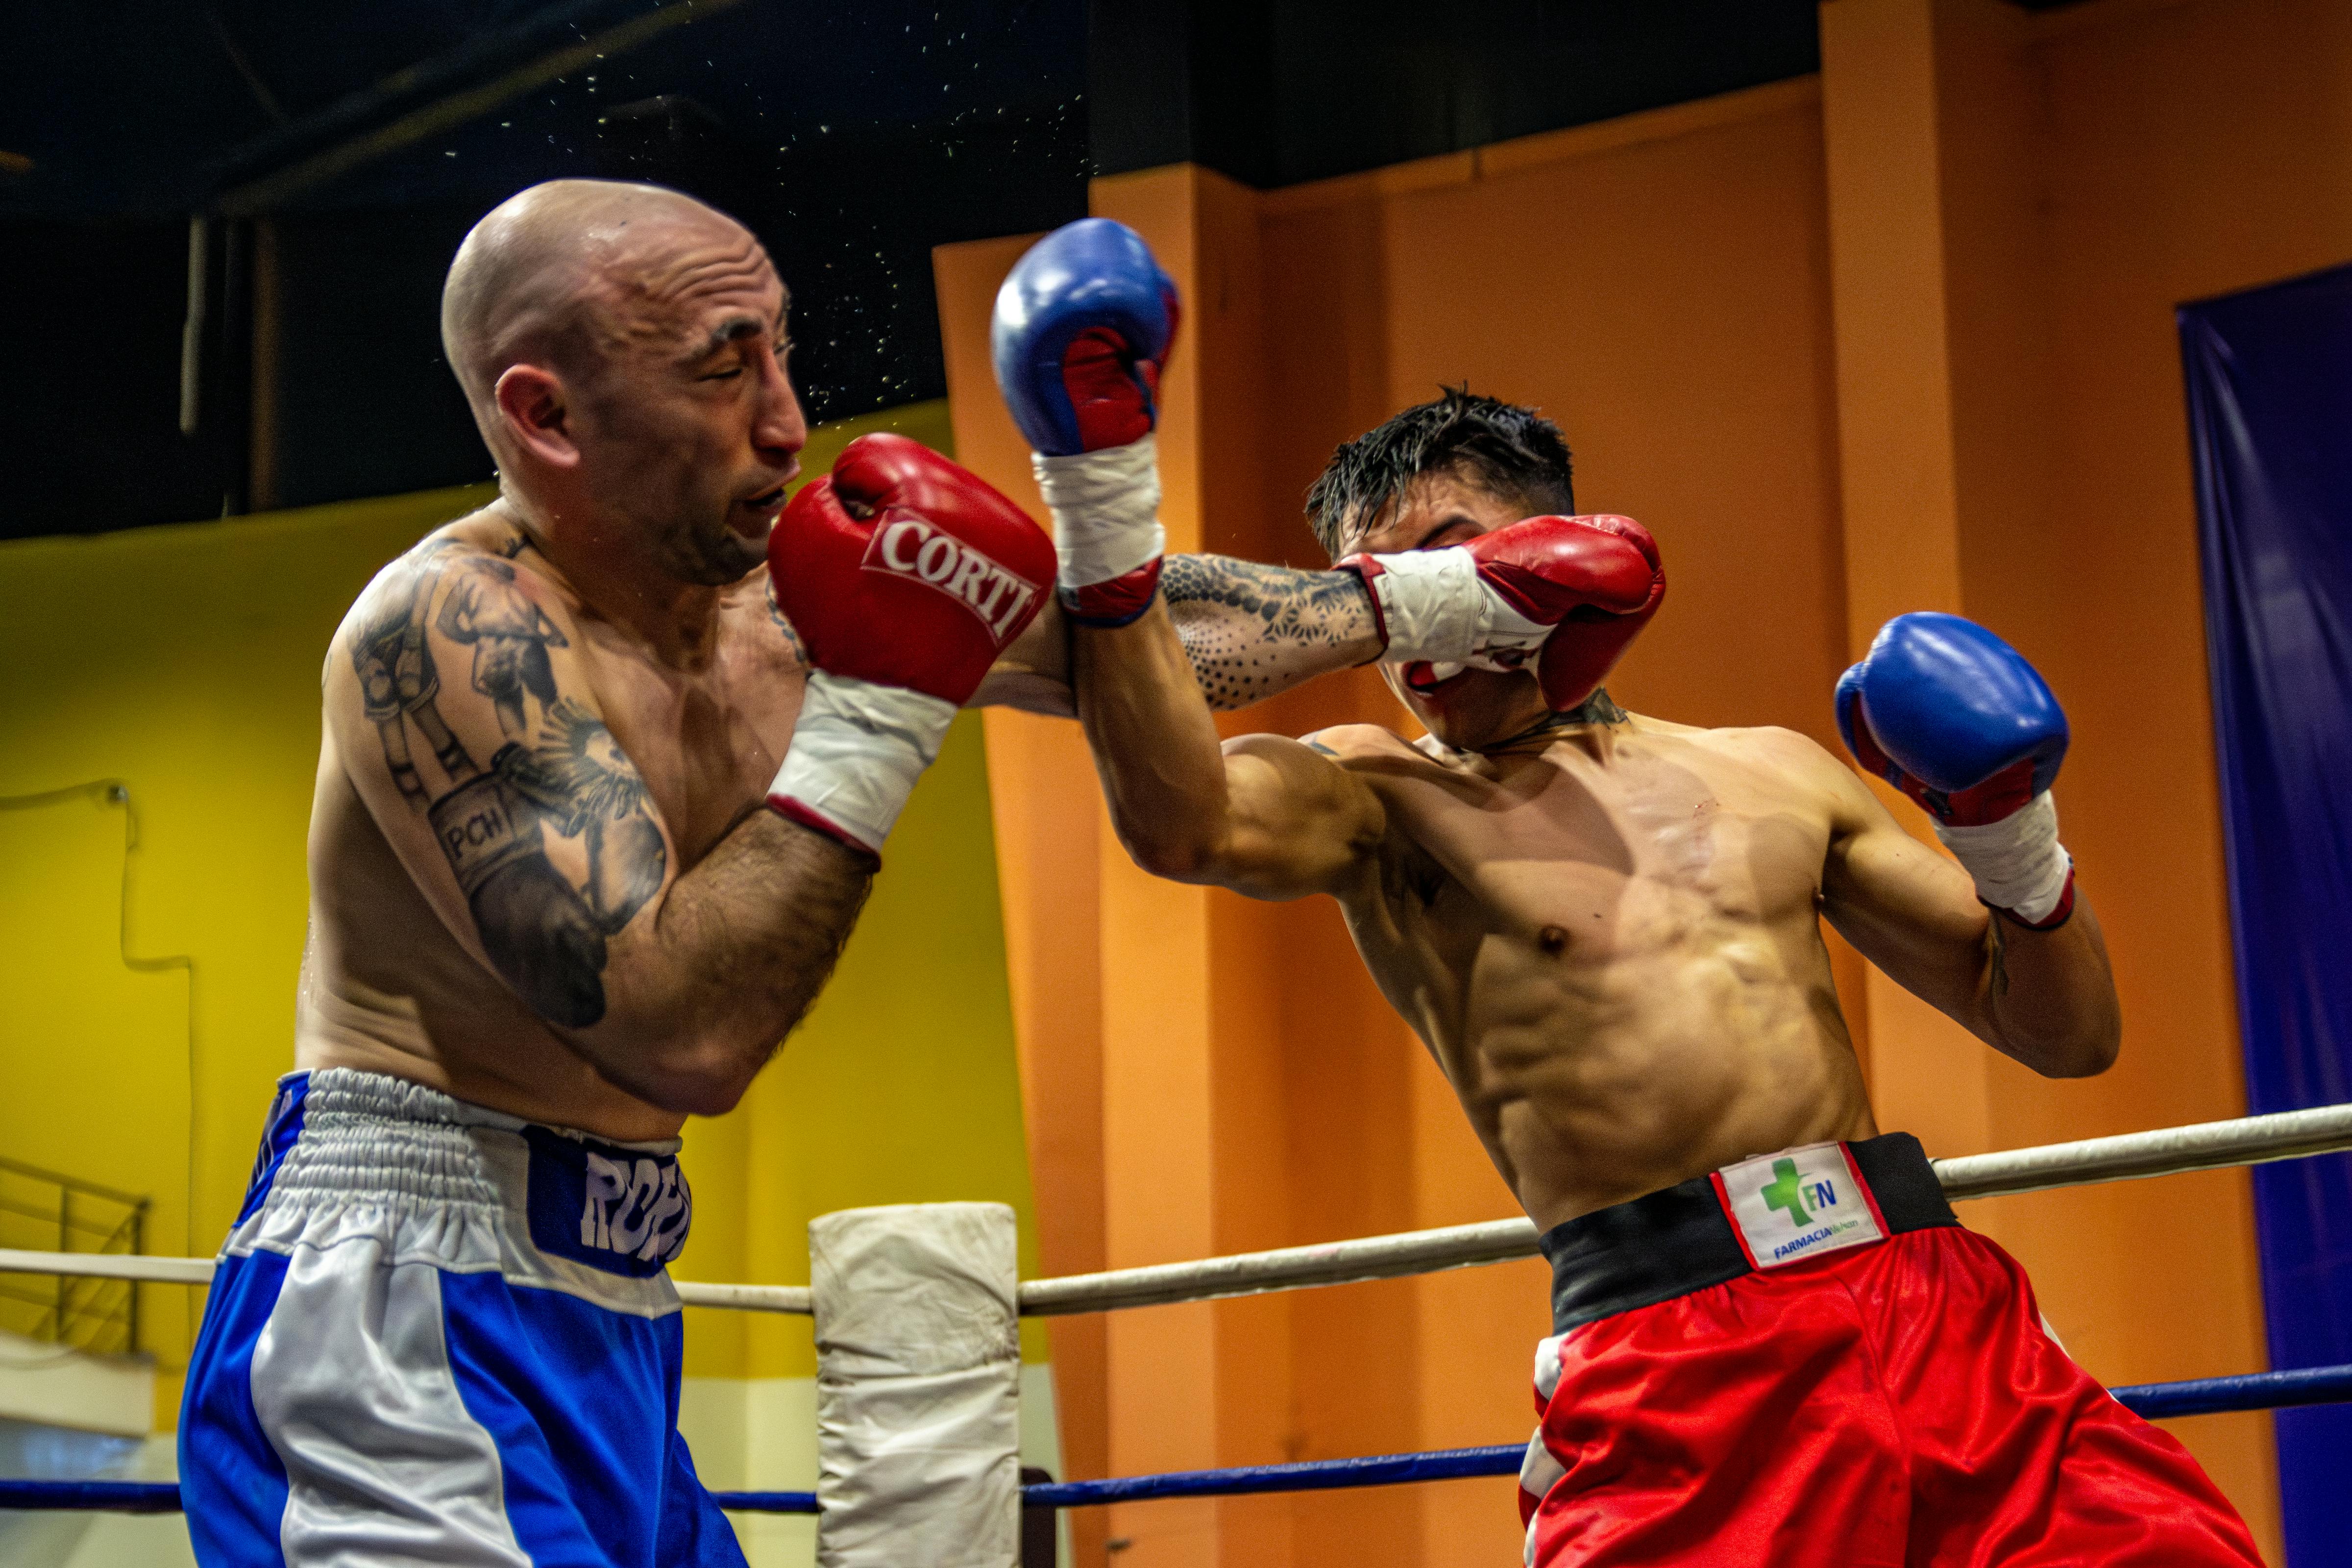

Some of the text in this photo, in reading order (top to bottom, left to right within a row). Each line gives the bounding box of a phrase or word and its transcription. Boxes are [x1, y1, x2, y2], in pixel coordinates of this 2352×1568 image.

[882, 520, 1034, 637] CORTI
[1801, 1179, 1837, 1212] FN
[1774, 1227, 1833, 1259] FARMACIA
